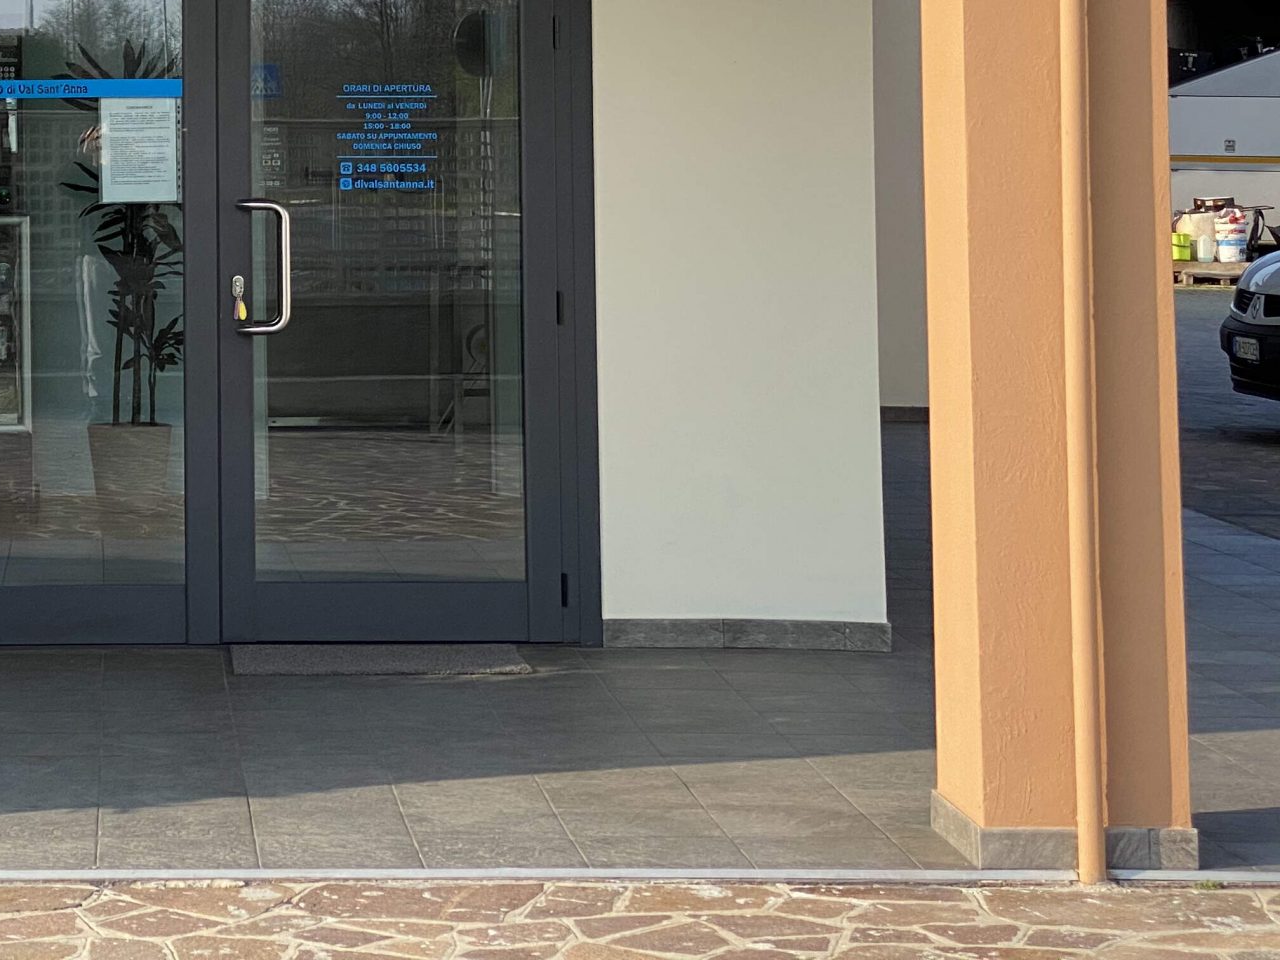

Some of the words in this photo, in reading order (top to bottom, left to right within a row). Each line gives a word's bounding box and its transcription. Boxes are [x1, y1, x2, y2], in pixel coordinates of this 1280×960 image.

[7, 84, 16, 95] di
[18, 84, 35, 95] Val
[37, 83, 88, 95] Sant'Anna
[343, 84, 371, 93] ORARI
[373, 84, 382, 93] DI
[384, 84, 432, 93] APERTURA
[365, 112, 382, 120] 9:00
[336, 132, 365, 140] SABATO
[366, 132, 377, 140] SU
[379, 132, 438, 140] APPUNTAMENTO
[356, 163, 377, 173] 348
[354, 179, 434, 189] divalsantanna.it
